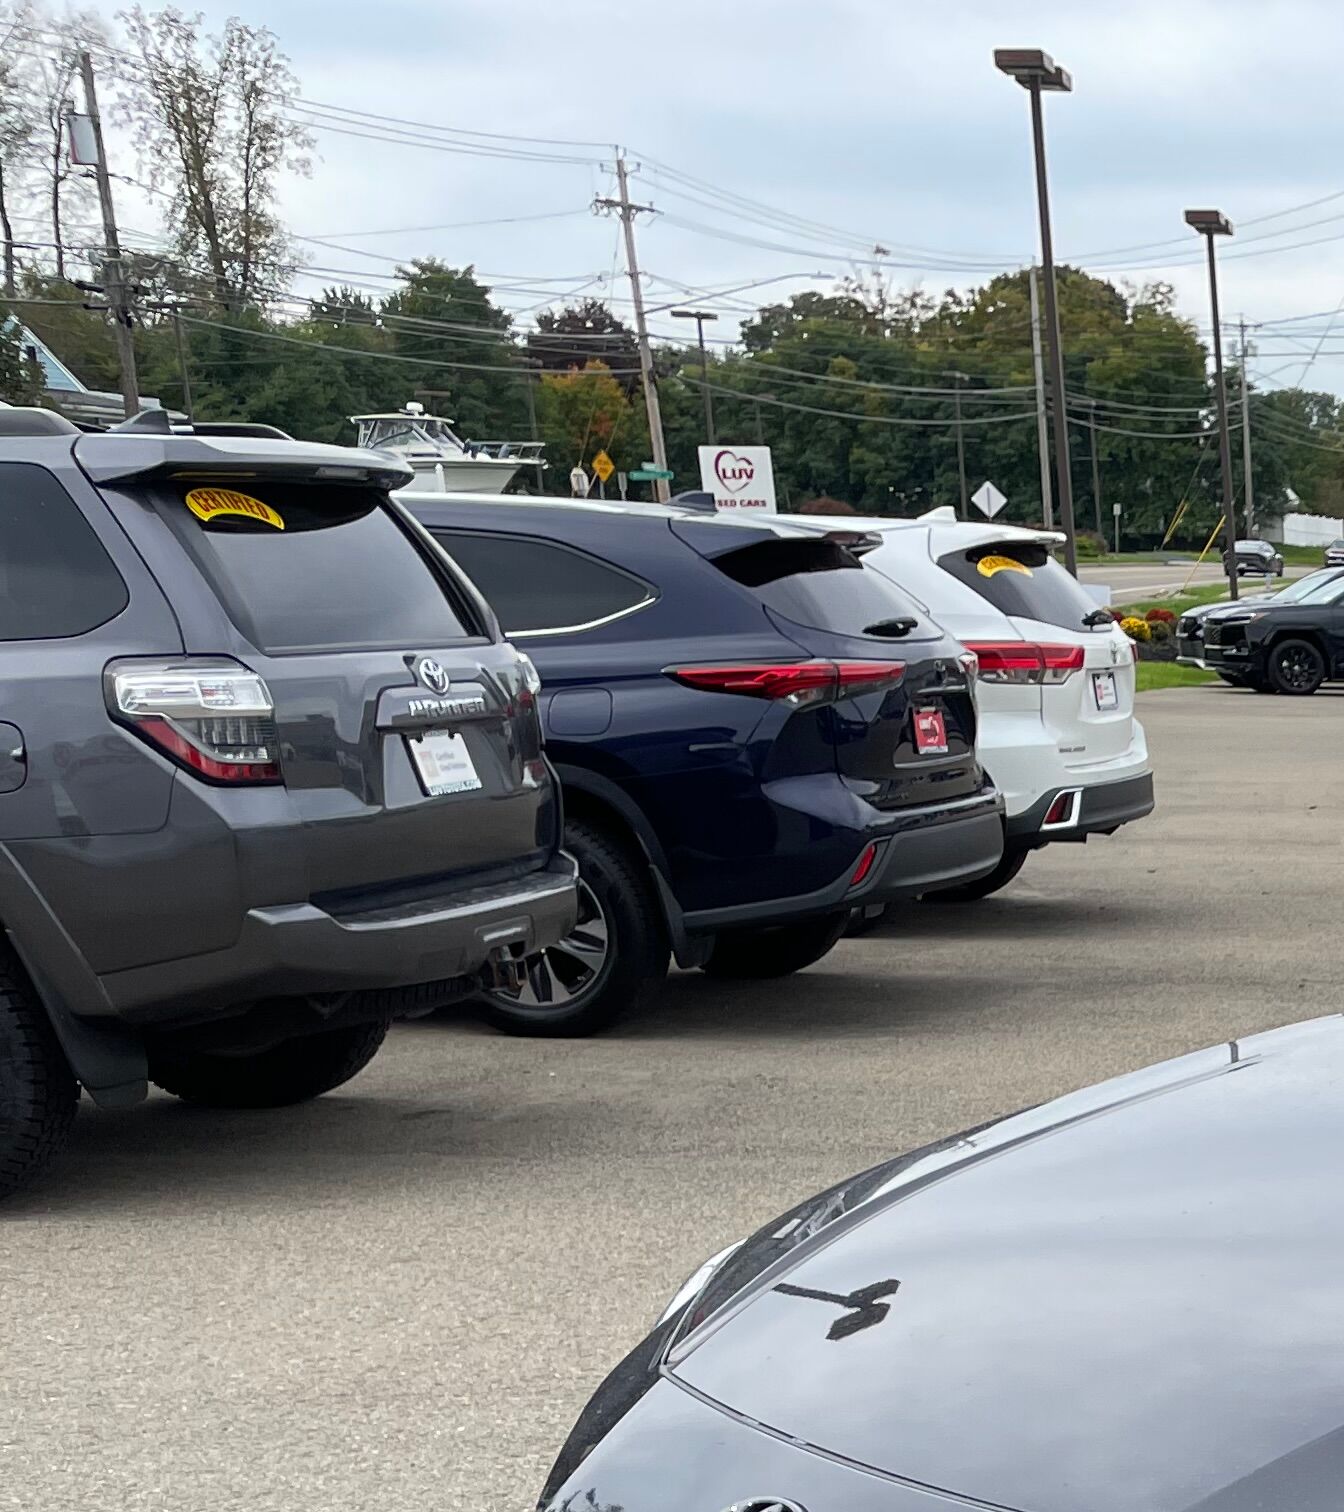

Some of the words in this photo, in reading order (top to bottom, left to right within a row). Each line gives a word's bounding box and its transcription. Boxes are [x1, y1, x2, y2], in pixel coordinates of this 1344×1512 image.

[722, 468, 754, 480] LUV
[190, 489, 271, 521] CERTIFIED
[717, 499, 737, 508] SED
[740, 499, 766, 508] CARS
